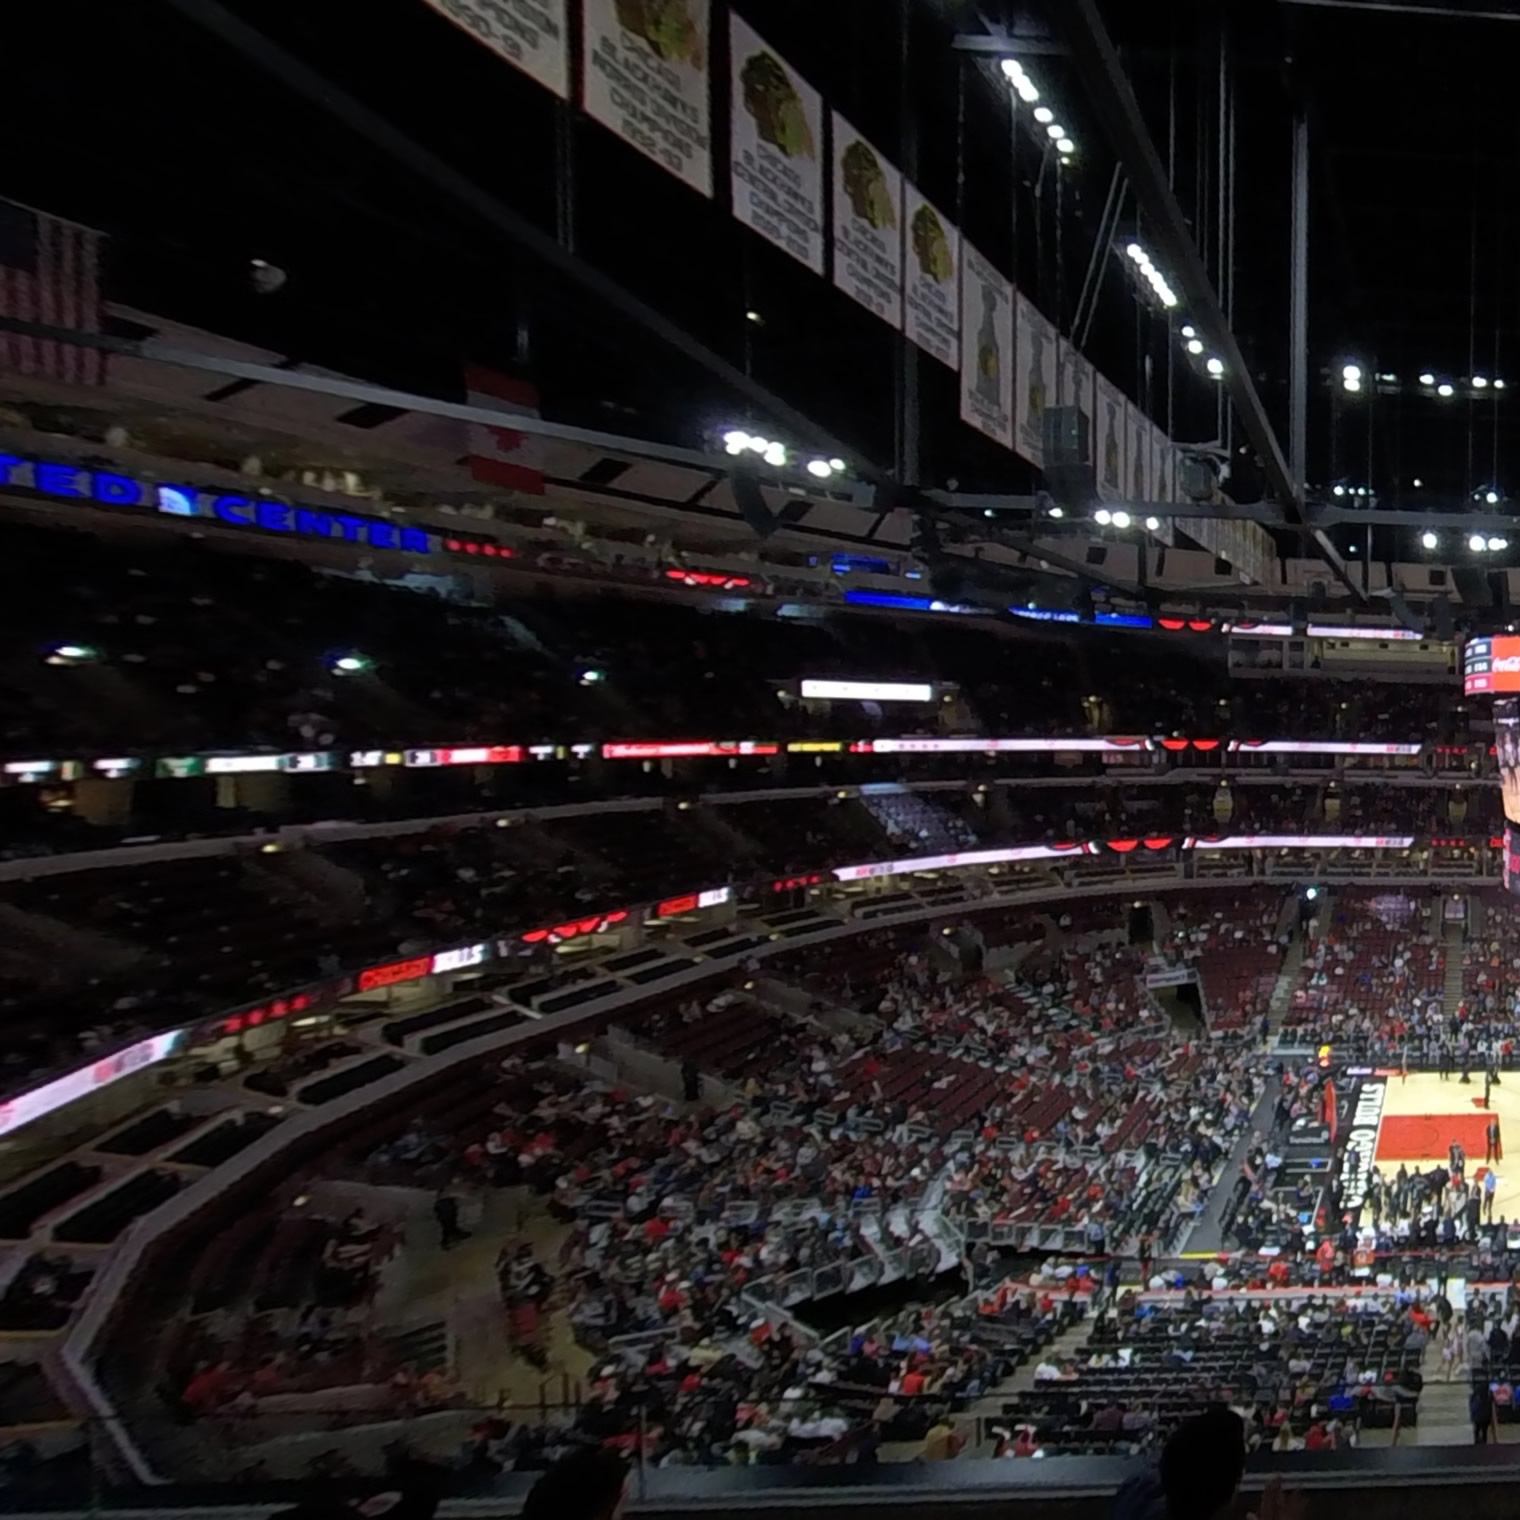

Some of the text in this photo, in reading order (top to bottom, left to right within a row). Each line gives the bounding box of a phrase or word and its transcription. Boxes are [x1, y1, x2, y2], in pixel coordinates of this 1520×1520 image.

[599, 36, 700, 124] BLACKHAWKS
[212, 494, 431, 554] CENTER
[431, 943, 485, 974] BULLS
[1352, 1083, 1385, 1126] BULLS
